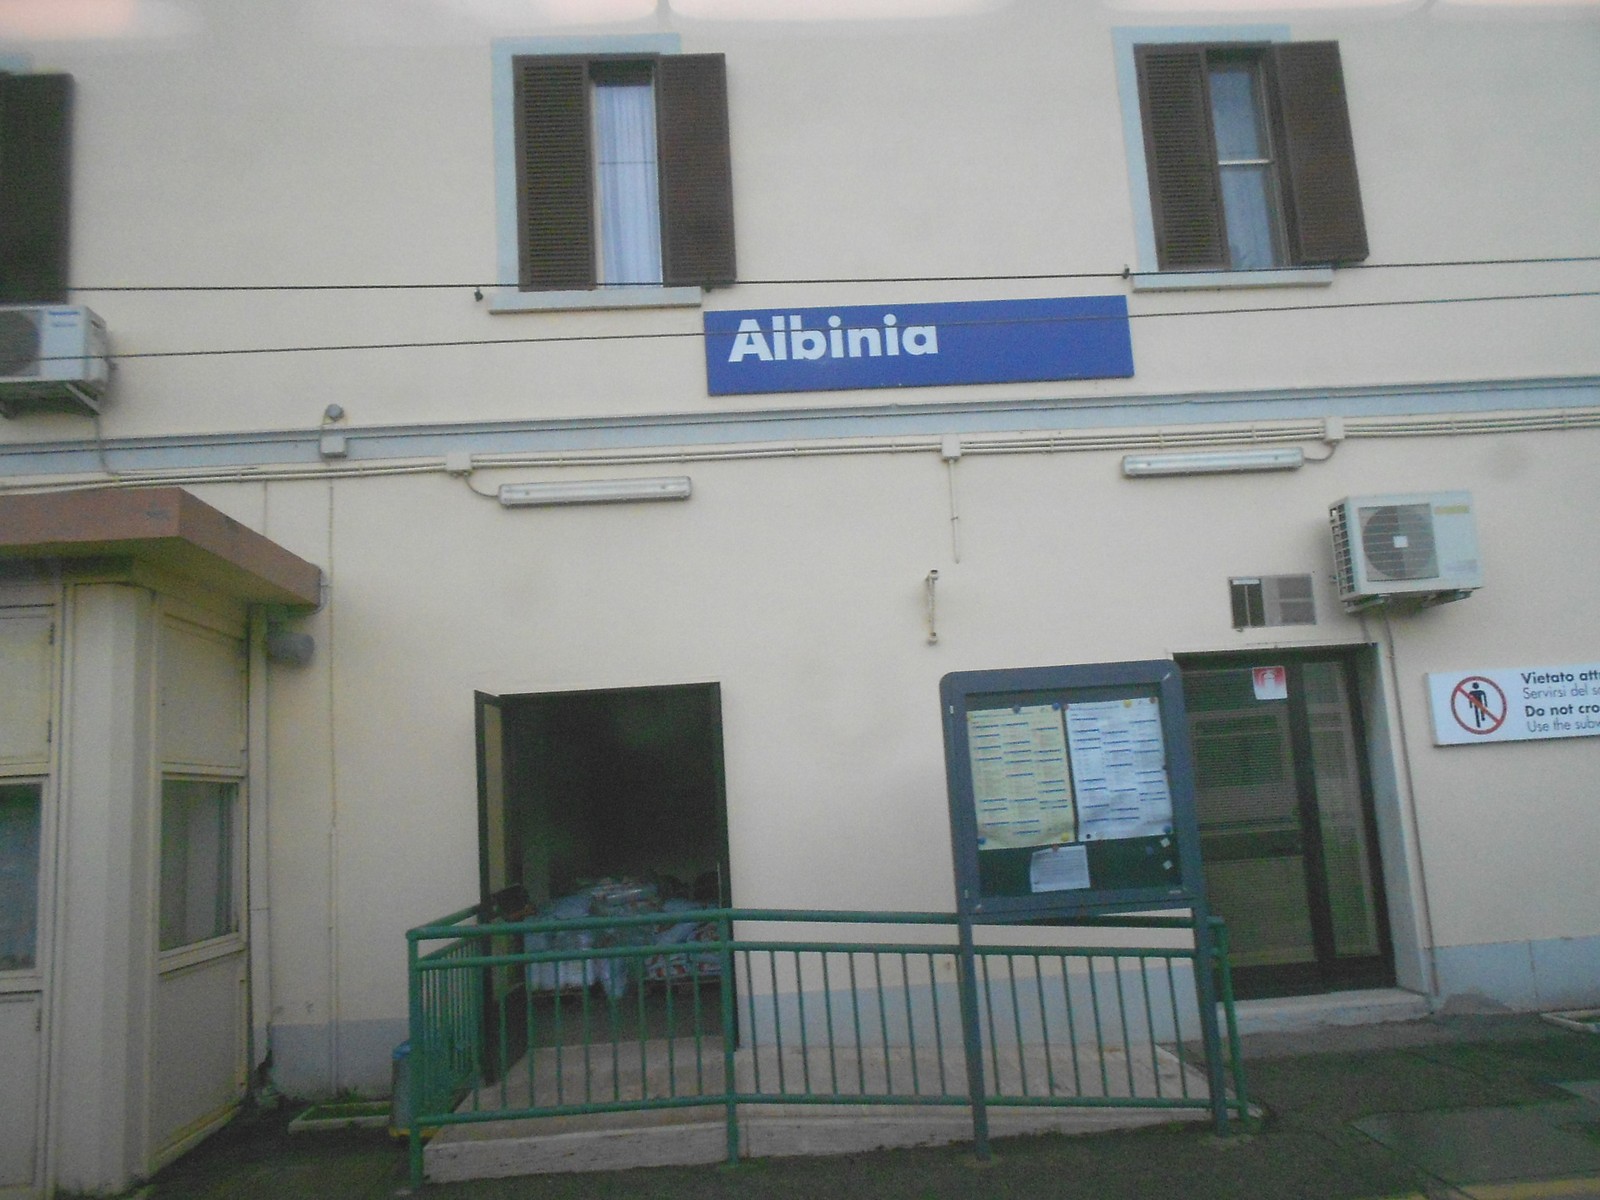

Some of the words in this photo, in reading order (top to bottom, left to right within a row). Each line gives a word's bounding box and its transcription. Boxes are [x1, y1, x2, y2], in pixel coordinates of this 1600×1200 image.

[728, 313, 939, 362] Albinia
[1520, 671, 1574, 684] Vietato
[1579, 669, 1600, 681] att
[1522, 685, 1567, 699] Servirsi
[1570, 682, 1588, 697] del
[1525, 705, 1545, 717] Do
[1550, 703, 1573, 716] not
[1527, 720, 1549, 733] Use
[1553, 717, 1571, 731] the
